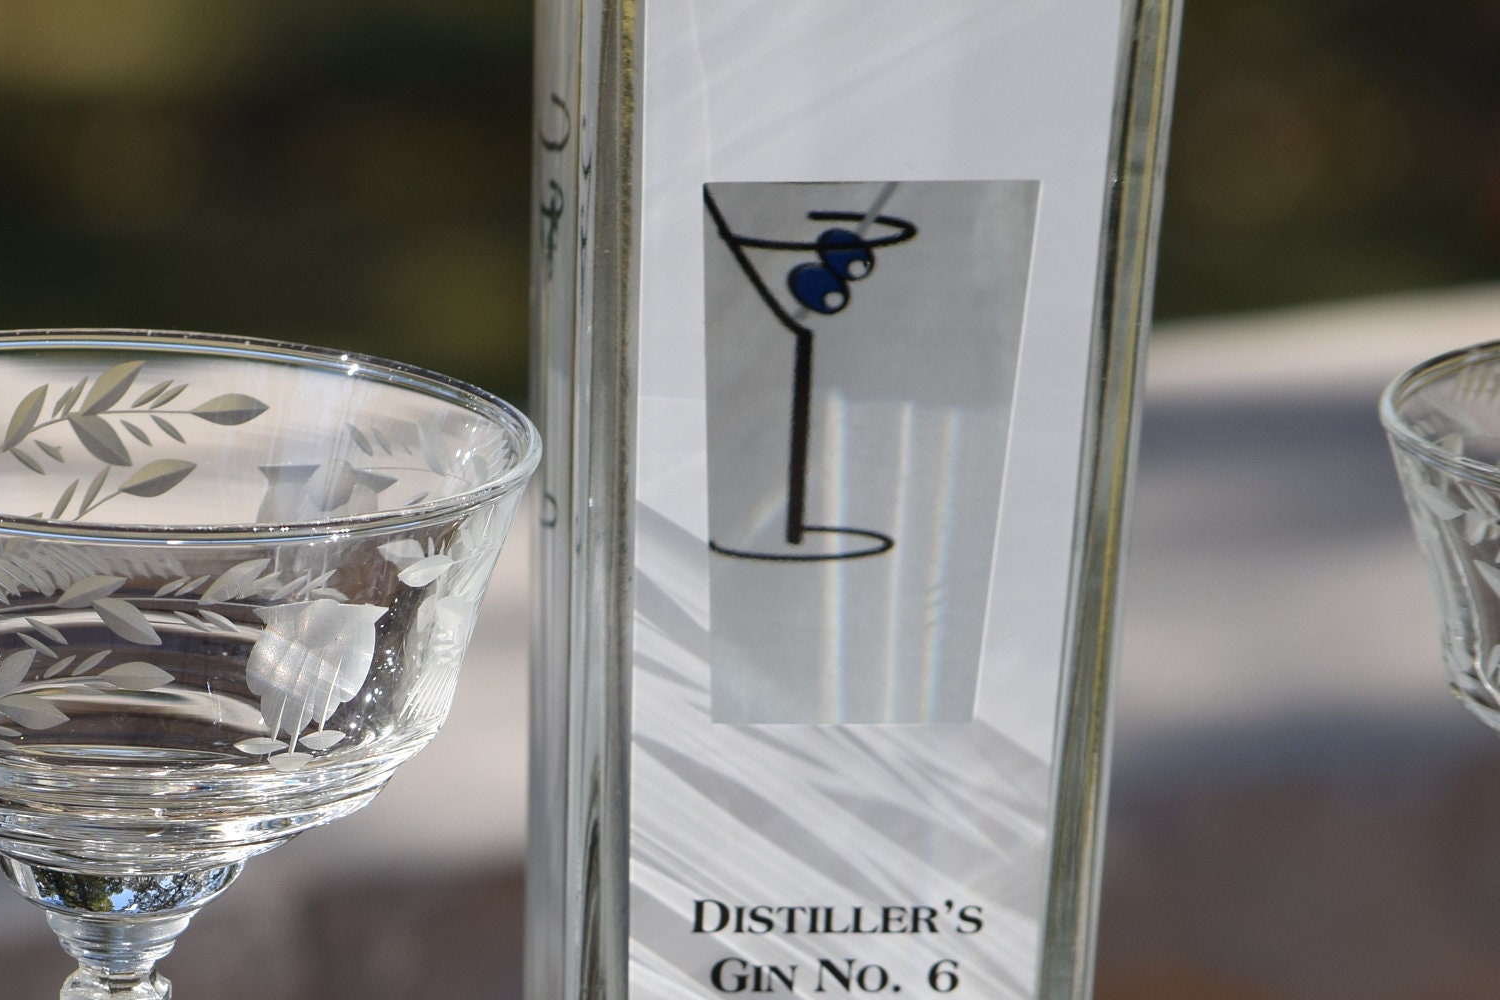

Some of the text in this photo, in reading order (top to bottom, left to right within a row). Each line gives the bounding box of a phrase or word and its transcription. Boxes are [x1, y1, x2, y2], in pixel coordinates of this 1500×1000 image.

[690, 899, 984, 934] DISTILLER'S
[709, 957, 959, 994] GIN NO. 6
